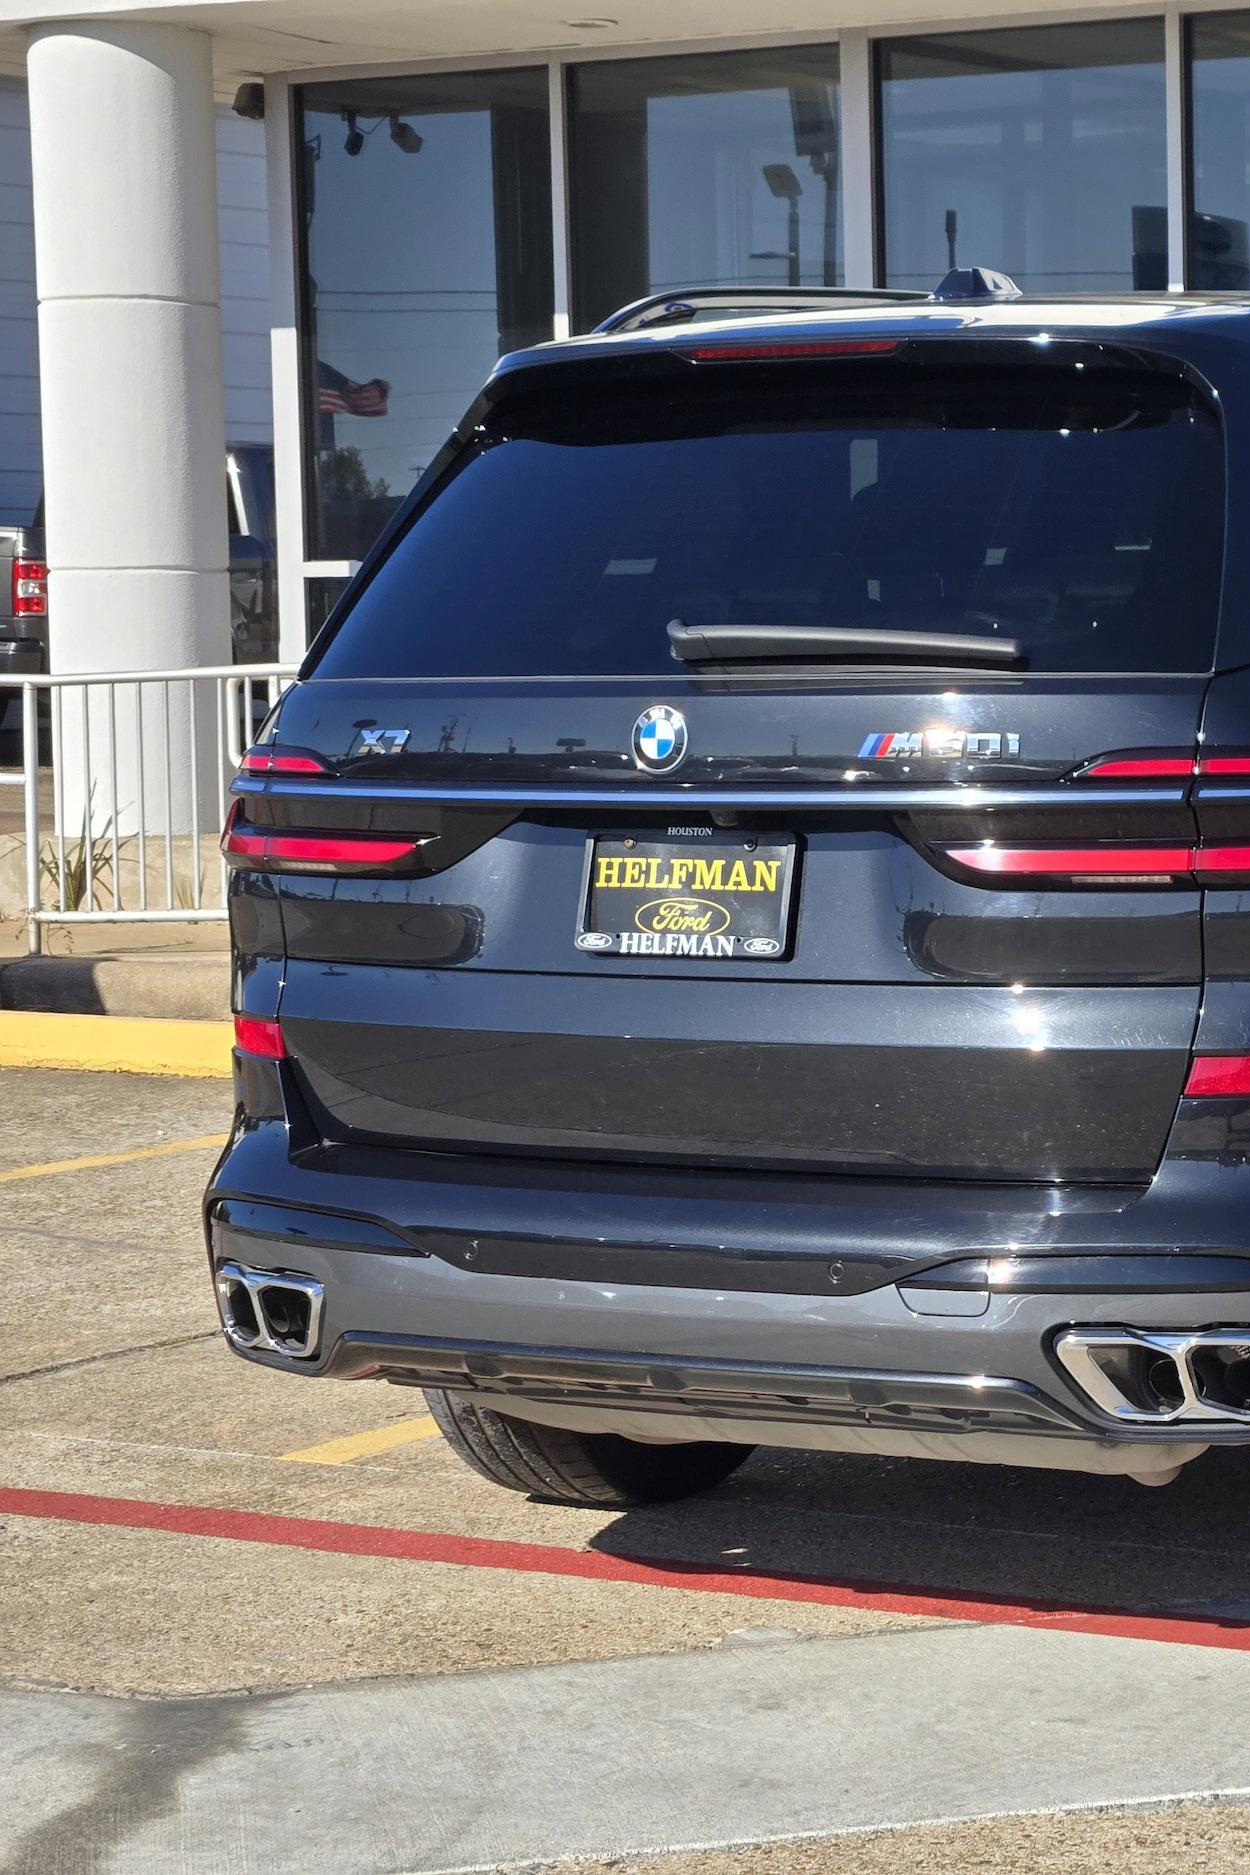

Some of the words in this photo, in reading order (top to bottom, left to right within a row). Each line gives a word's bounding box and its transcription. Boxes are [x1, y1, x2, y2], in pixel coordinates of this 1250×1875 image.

[358, 729, 411, 754] X7
[667, 826, 713, 836] HOUSTON
[595, 857, 782, 892] HELFMAN
[652, 902, 713, 932] Ford
[619, 932, 736, 957] HELFMAN
